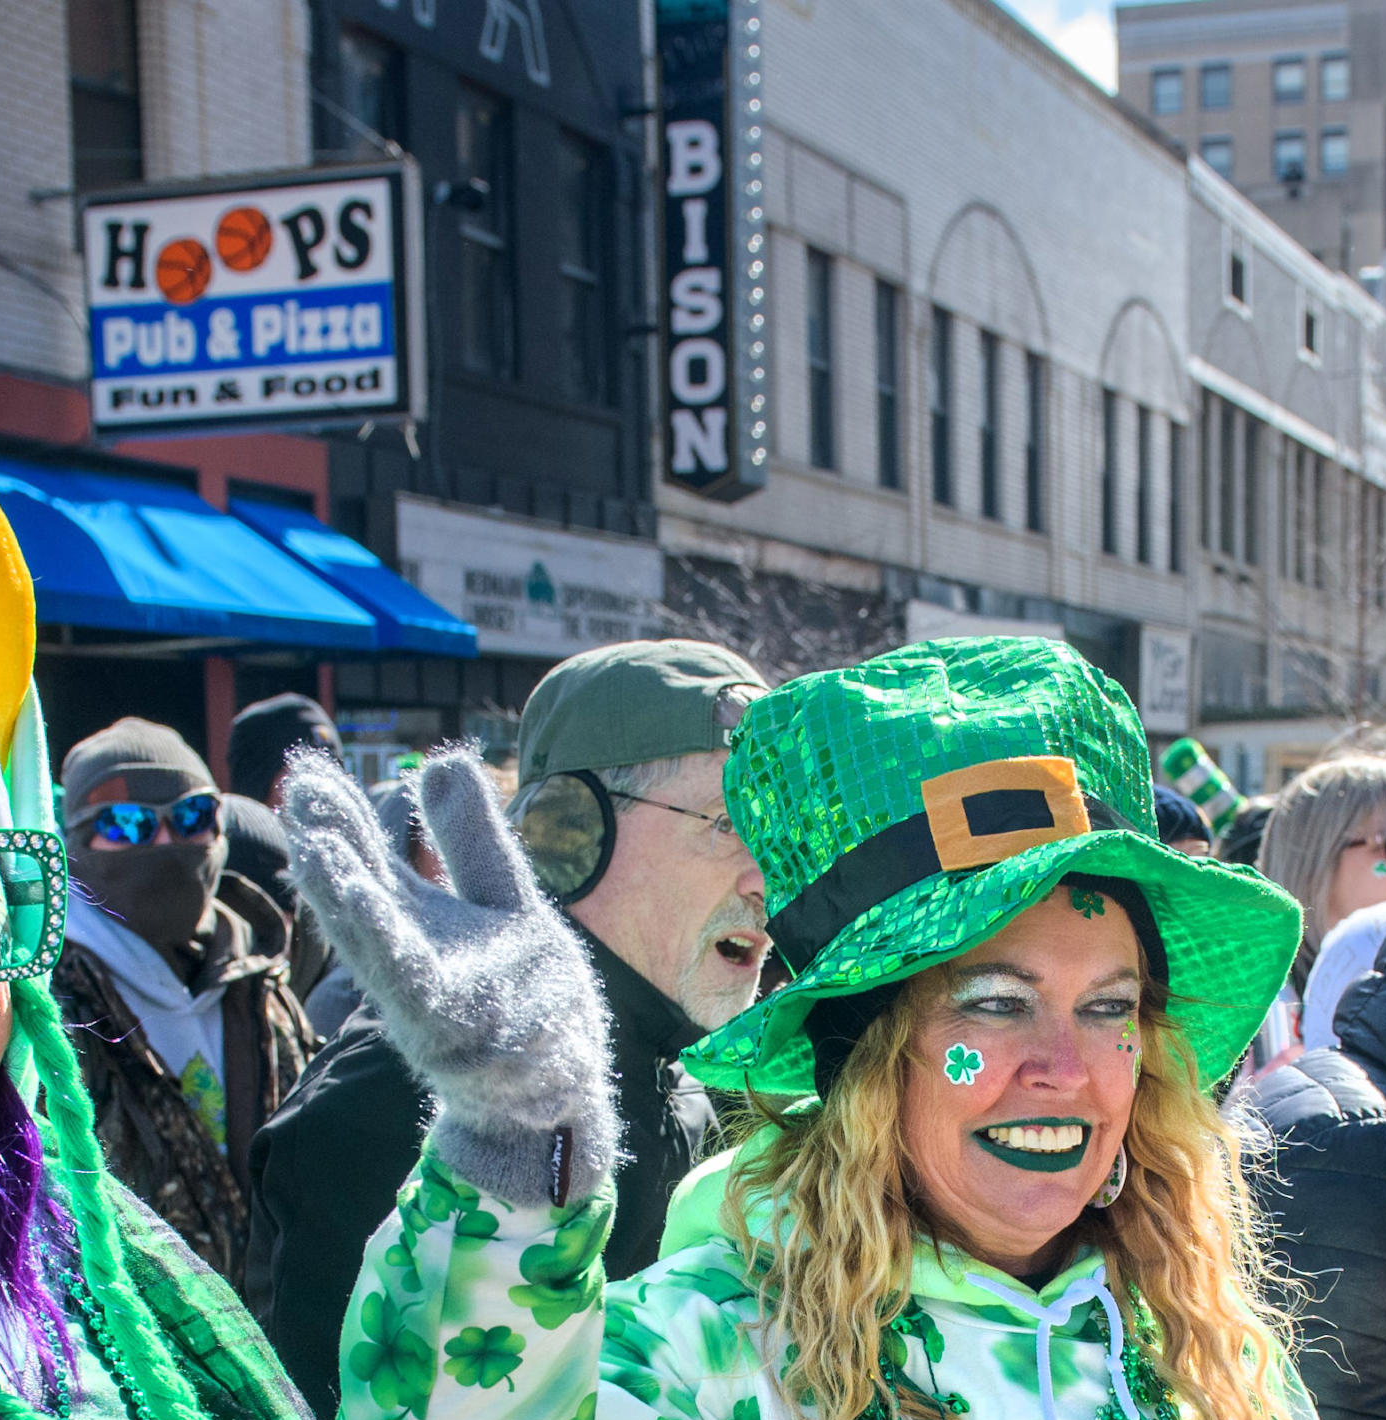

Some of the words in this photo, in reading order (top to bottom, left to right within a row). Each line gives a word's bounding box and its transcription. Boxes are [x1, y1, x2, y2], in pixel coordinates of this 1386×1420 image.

[667, 121, 728, 474] BISON
[103, 313, 198, 369] Pub
[206, 308, 242, 362] &
[251, 300, 383, 358] Pizza
[111, 386, 198, 410] Fun
[215, 379, 242, 401] &
[262, 368, 381, 398] Food
